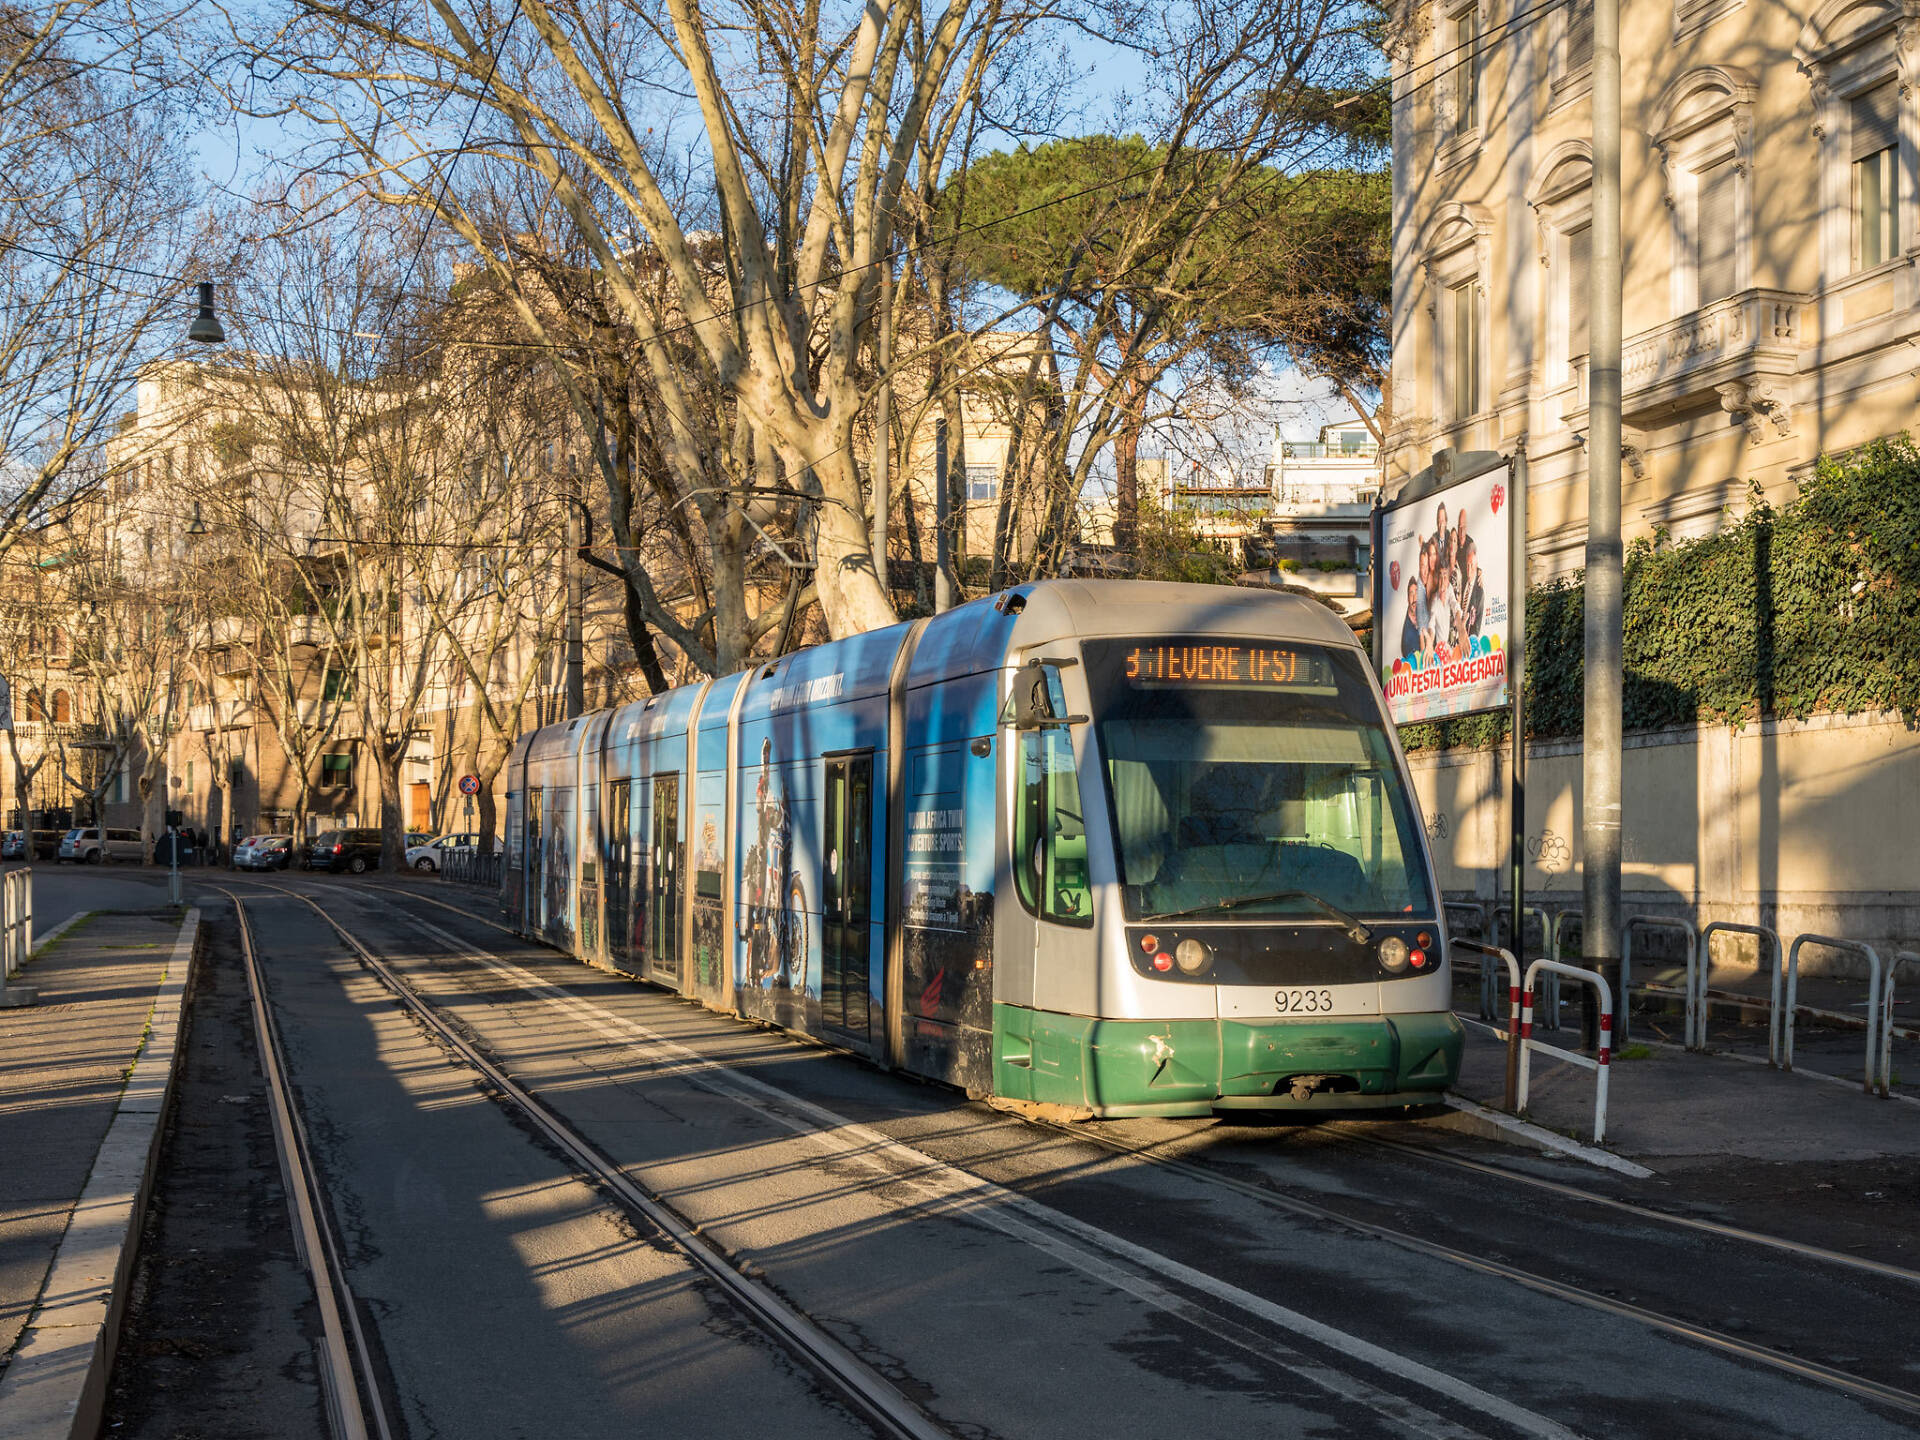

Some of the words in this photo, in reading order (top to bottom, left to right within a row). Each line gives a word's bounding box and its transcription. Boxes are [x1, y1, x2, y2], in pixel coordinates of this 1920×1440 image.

[1492, 596, 1500, 605] DAL
[1485, 607, 1491, 617] 22
[1491, 603, 1506, 614] MARZO
[1485, 617, 1491, 625] AL
[1491, 612, 1506, 624] CINEMA
[1389, 676, 1409, 698] UNA
[1411, 667, 1440, 693] FESTA
[1443, 653, 1504, 689] ESAGERATA
[1275, 990, 1332, 1012] 9233
